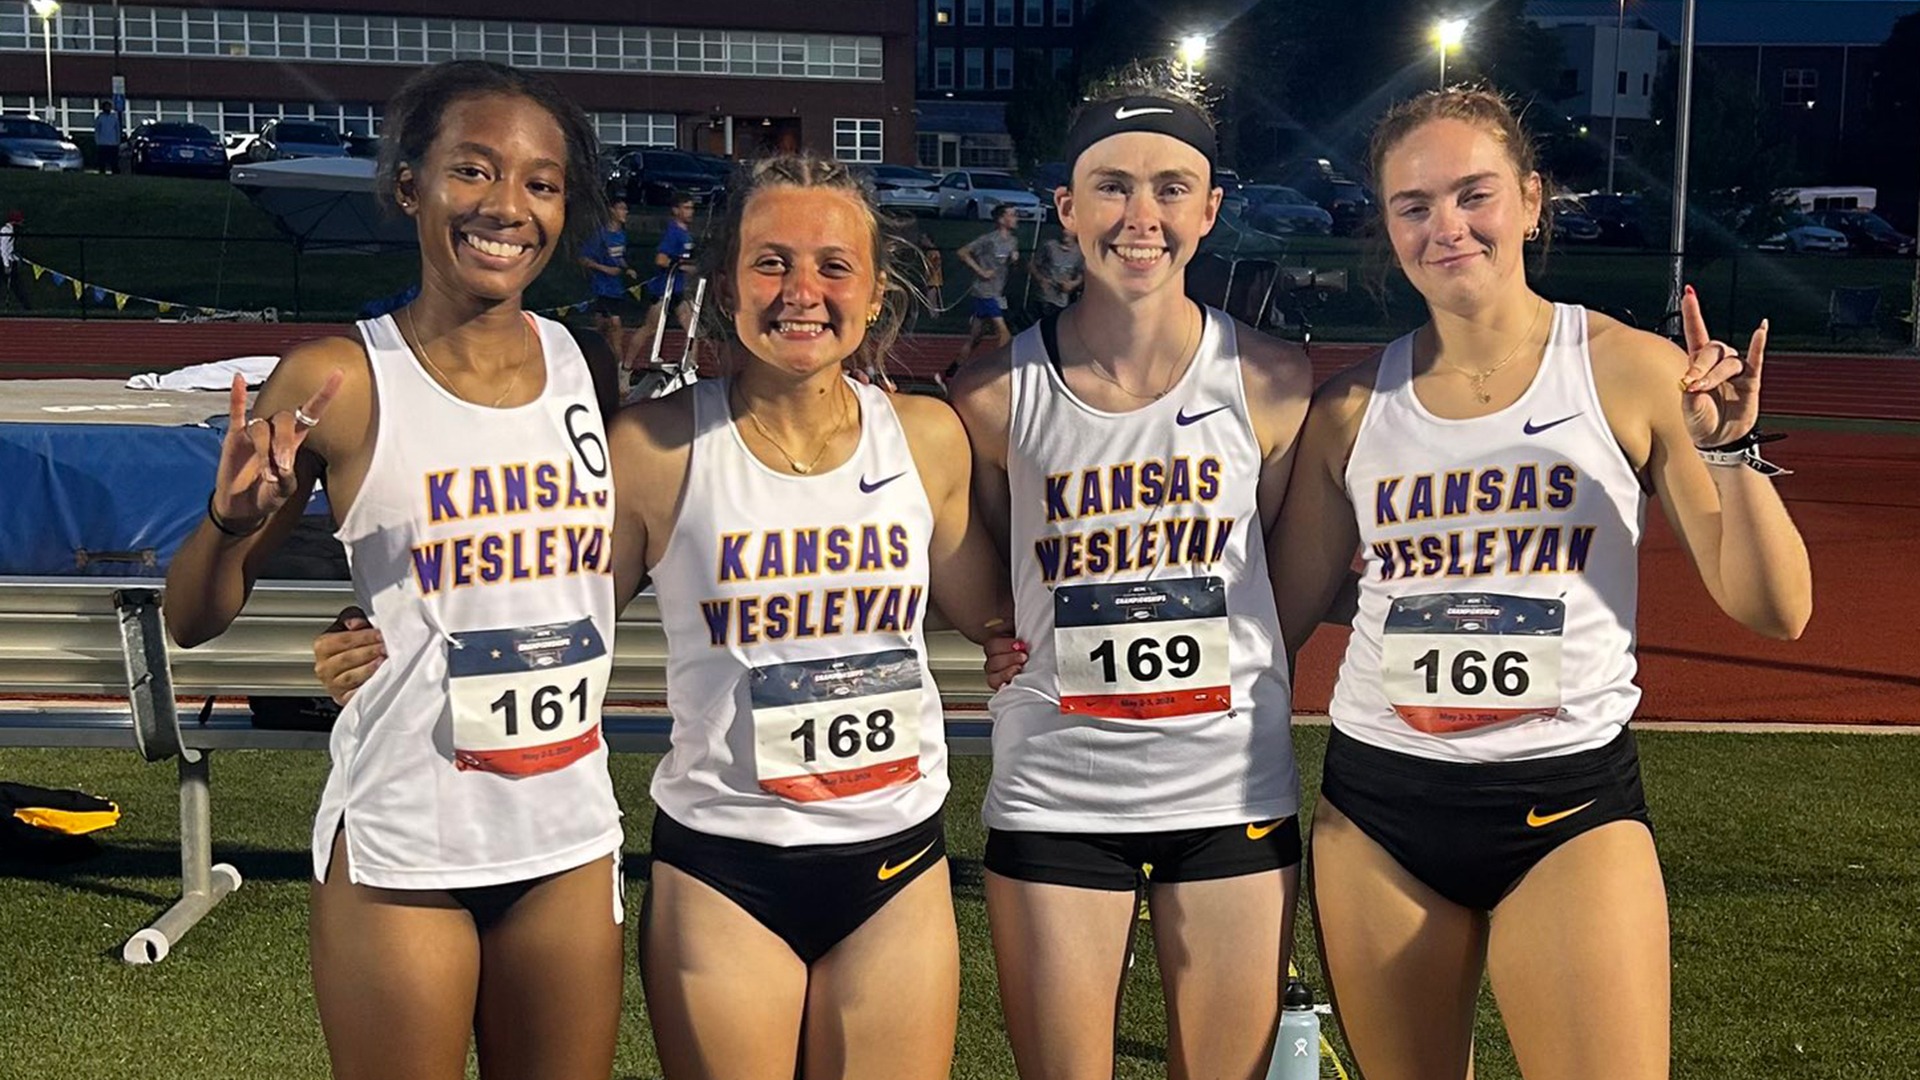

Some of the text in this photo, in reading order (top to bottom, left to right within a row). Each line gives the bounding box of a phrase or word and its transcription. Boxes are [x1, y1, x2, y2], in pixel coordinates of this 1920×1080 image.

[564, 403, 607, 478] 6
[1045, 455, 1223, 523] KANSAS
[1375, 460, 1577, 527] KANSAS
[411, 525, 612, 598] WESLEYA
[718, 522, 909, 584] KANSAS
[1035, 517, 1235, 583] WESLEYAN
[1370, 525, 1597, 583] WESLEYAN
[700, 584, 922, 648] WESLEYAN
[1090, 635, 1201, 683] 169
[1414, 649, 1530, 697] 166
[490, 677, 588, 736] 161
[791, 709, 895, 763] 168
